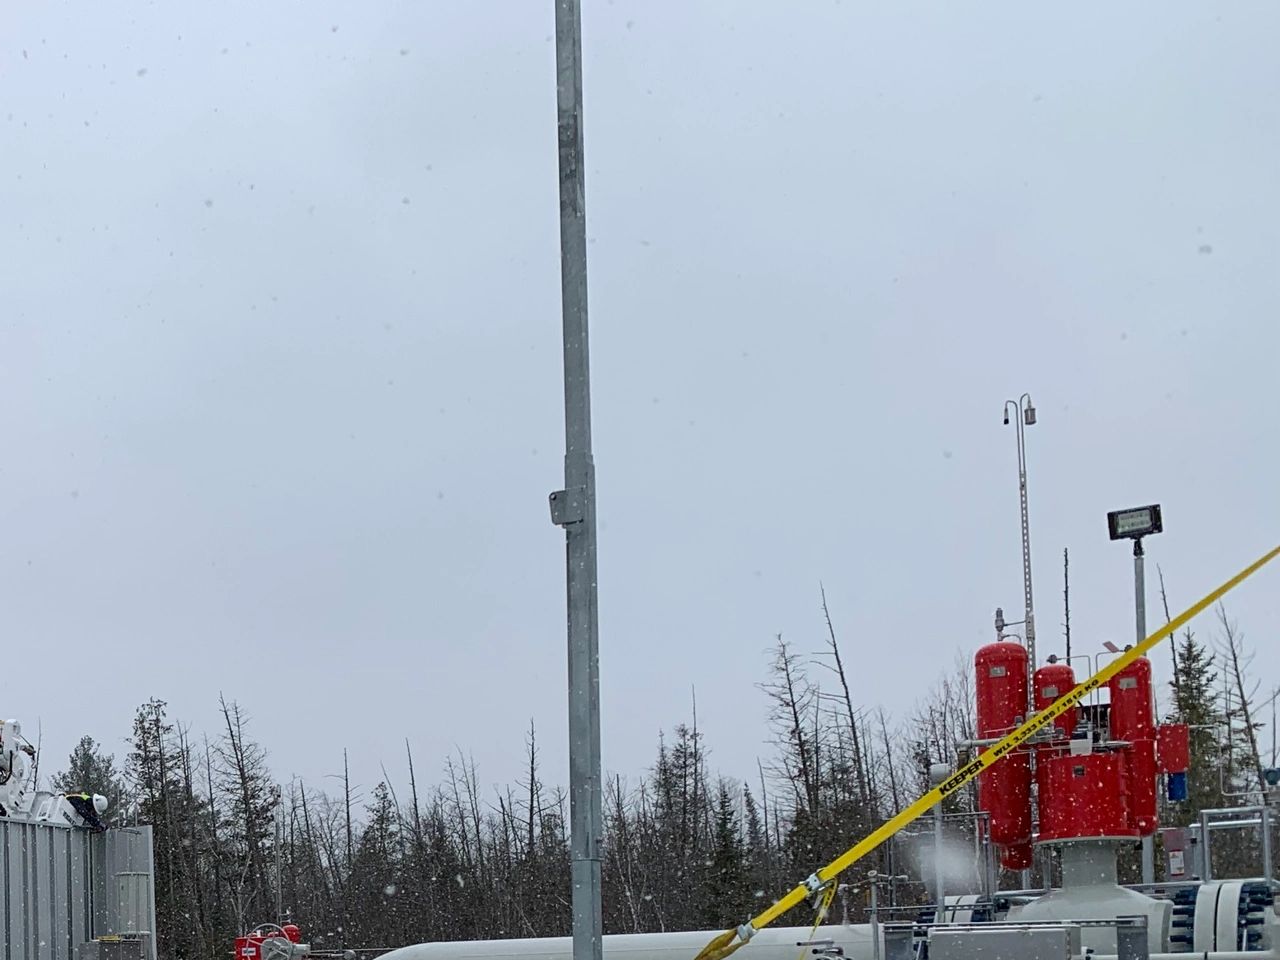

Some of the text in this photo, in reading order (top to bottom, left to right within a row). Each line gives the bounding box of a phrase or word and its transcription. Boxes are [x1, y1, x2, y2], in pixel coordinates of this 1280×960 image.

[939, 760, 984, 795] KEEPER
[993, 741, 1012, 757] WLL
[1085, 679, 1099, 691] KG
